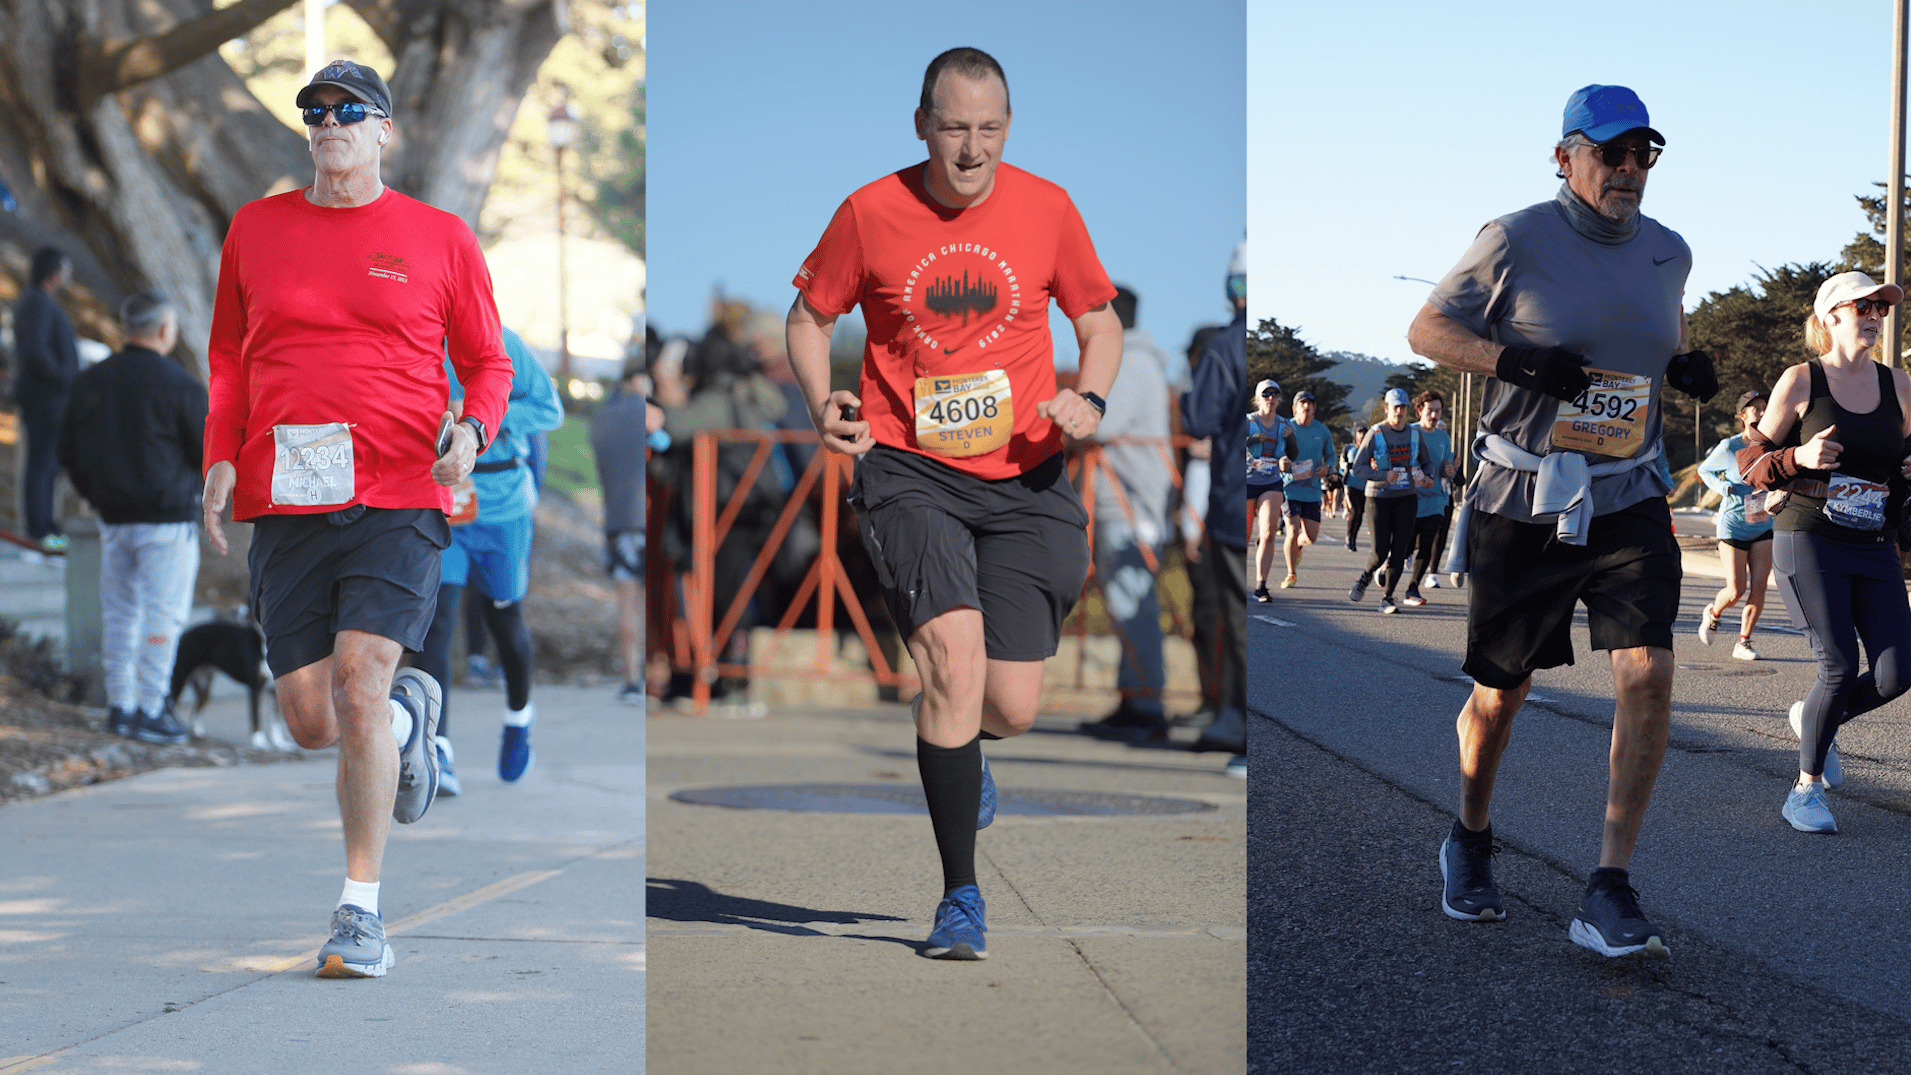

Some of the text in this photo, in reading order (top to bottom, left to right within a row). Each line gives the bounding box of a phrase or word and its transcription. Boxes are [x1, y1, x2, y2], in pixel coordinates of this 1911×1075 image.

[902, 252, 937, 302] AMERICA
[940, 242, 997, 261] CHICAGO
[998, 260, 1021, 322] MARATHON
[953, 383, 972, 393] BAY
[1602, 380, 1620, 389] BAY
[929, 395, 998, 424] 4608
[1572, 390, 1637, 422] 4592
[939, 426, 993, 441] STEVEN
[1572, 420, 1631, 439] GREGORY
[963, 441, 970, 449] D
[1597, 437, 1604, 445] D
[280, 444, 349, 470] 12234
[288, 475, 337, 488] MICHAEL
[310, 490, 318, 500] H
[1836, 482, 1884, 508] 2244
[1833, 502, 1882, 521] KYMBERLIE
